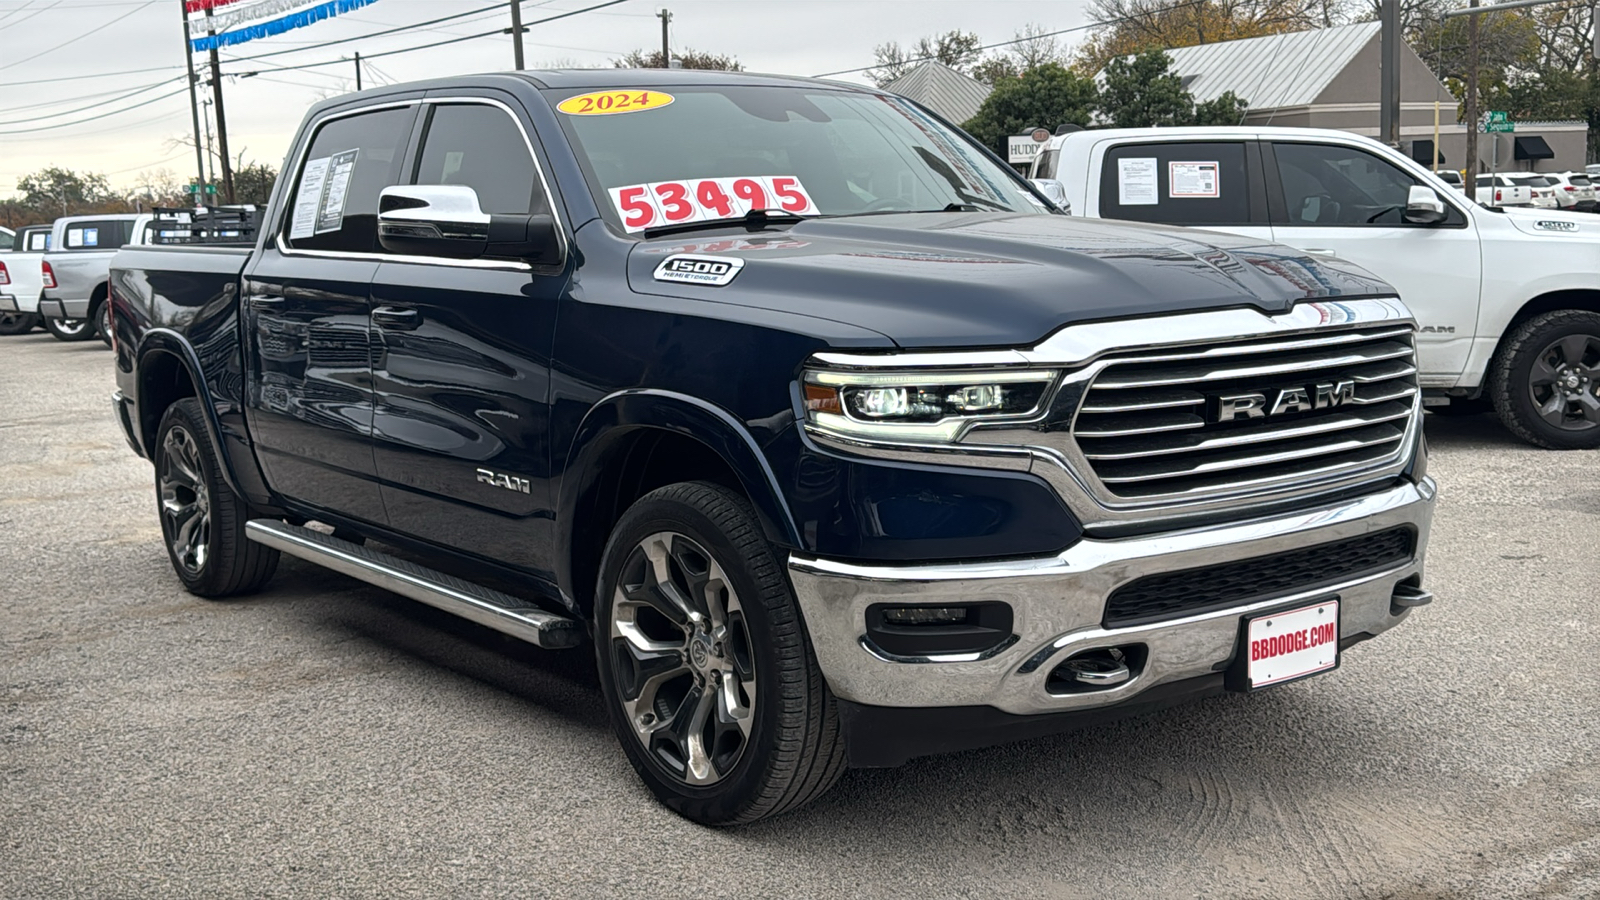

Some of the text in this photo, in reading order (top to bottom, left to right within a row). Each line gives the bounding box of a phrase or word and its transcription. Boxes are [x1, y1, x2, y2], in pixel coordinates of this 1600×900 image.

[578, 92, 650, 113] 2024
[619, 178, 811, 228] 53495
[671, 260, 729, 274] 1500
[1218, 380, 1355, 422] RAM
[476, 468, 531, 494] RAM
[1252, 622, 1334, 661] BBDODGE.COM
